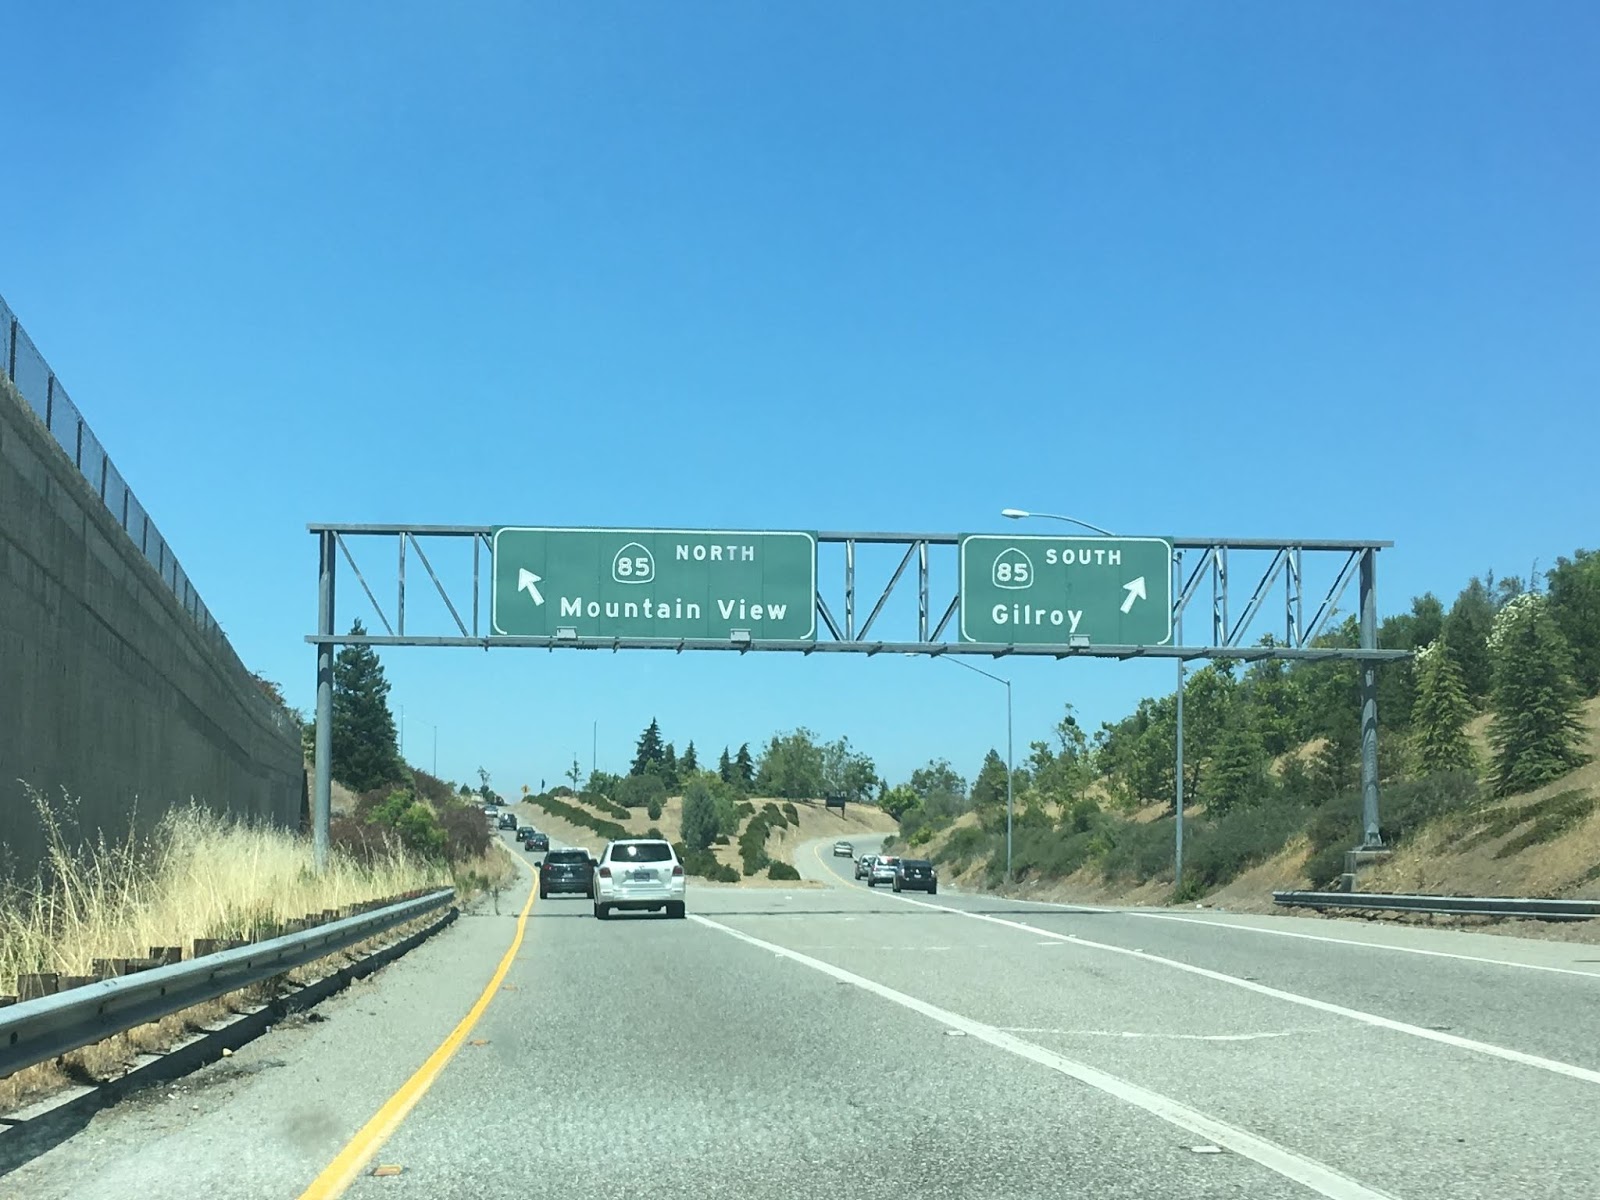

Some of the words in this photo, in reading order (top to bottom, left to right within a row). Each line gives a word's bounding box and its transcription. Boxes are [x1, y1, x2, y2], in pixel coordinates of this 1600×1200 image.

[676, 544, 754, 561] NORTH
[1046, 548, 1121, 565] SOUTH
[617, 557, 650, 577] 85
[996, 562, 1029, 582] 85
[560, 596, 701, 619] Mountain
[717, 598, 787, 620] View
[992, 603, 1083, 634] Gilroy
